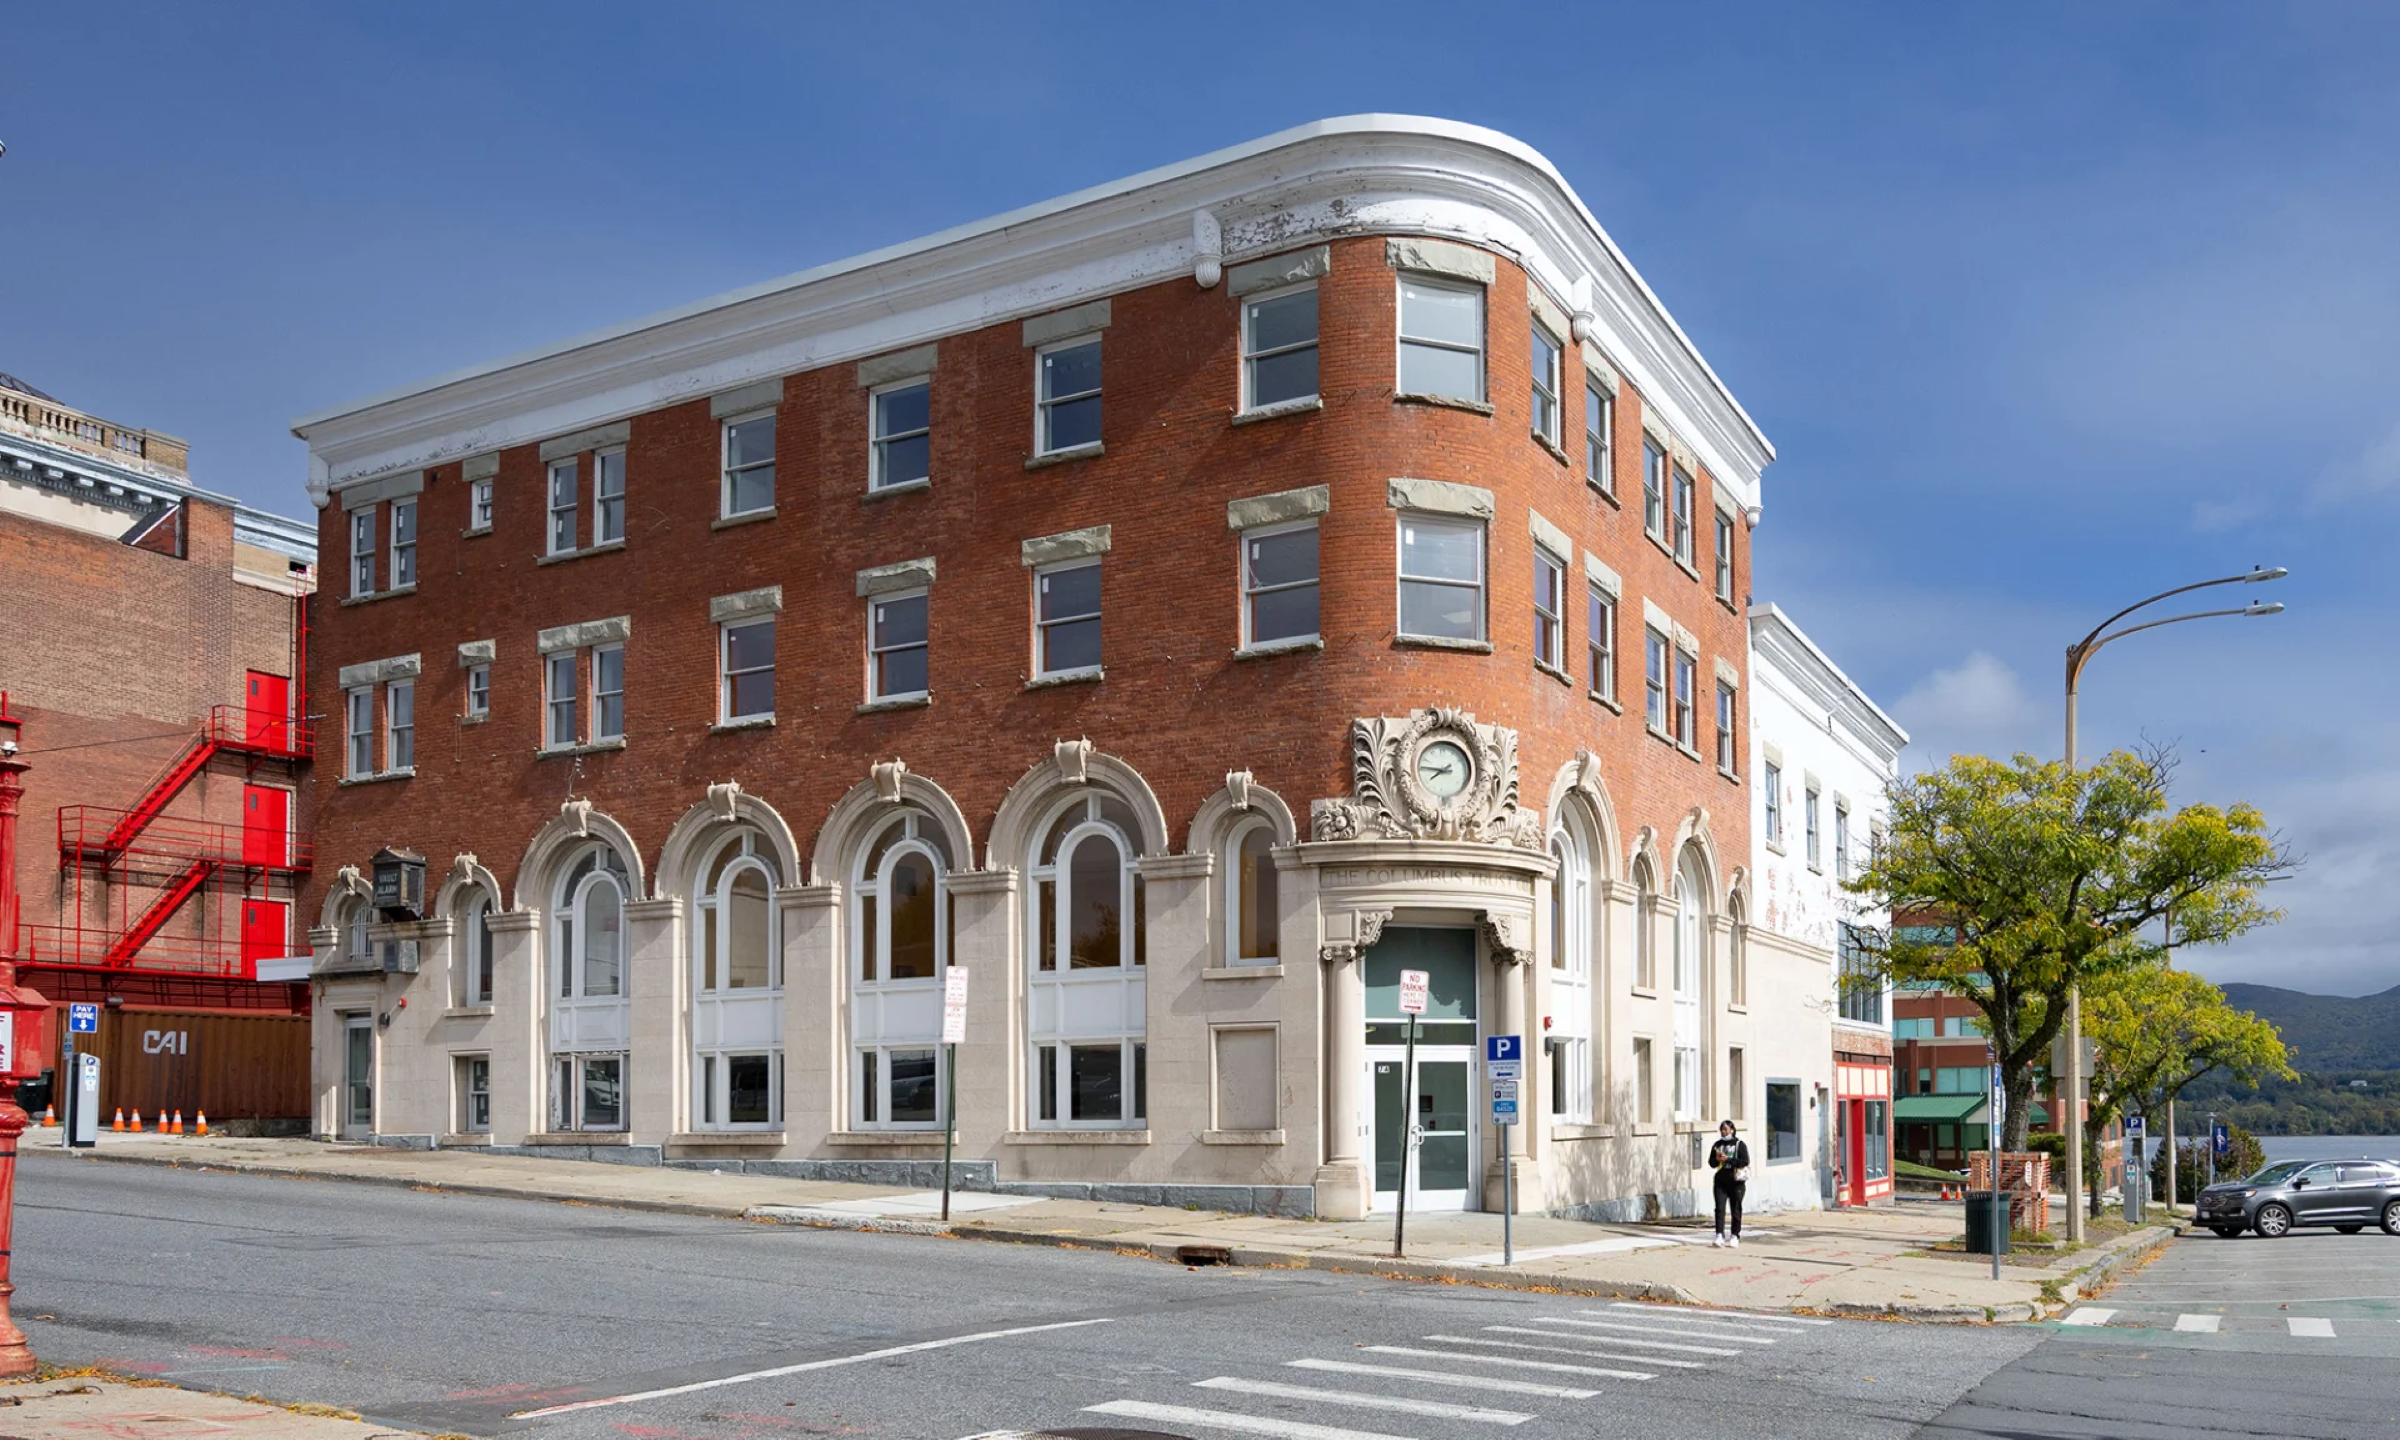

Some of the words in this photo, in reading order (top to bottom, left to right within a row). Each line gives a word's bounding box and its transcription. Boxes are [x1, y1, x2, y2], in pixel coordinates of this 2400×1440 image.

[379, 873, 398, 883] VAULT
[1326, 869, 1360, 885] THE
[1365, 868, 1463, 885] COLUMBUS
[1468, 871, 1513, 888] TRUST
[378, 884, 398, 894] ALARM
[1409, 975, 1421, 983] NO
[1402, 982, 1426, 992] PARKING
[75, 1005, 93, 1013] PAY
[73, 1011, 95, 1020] HERE
[143, 1030, 187, 1055] CAI
[1496, 1039, 1512, 1058] P
[2130, 1118, 2139, 1128] P
